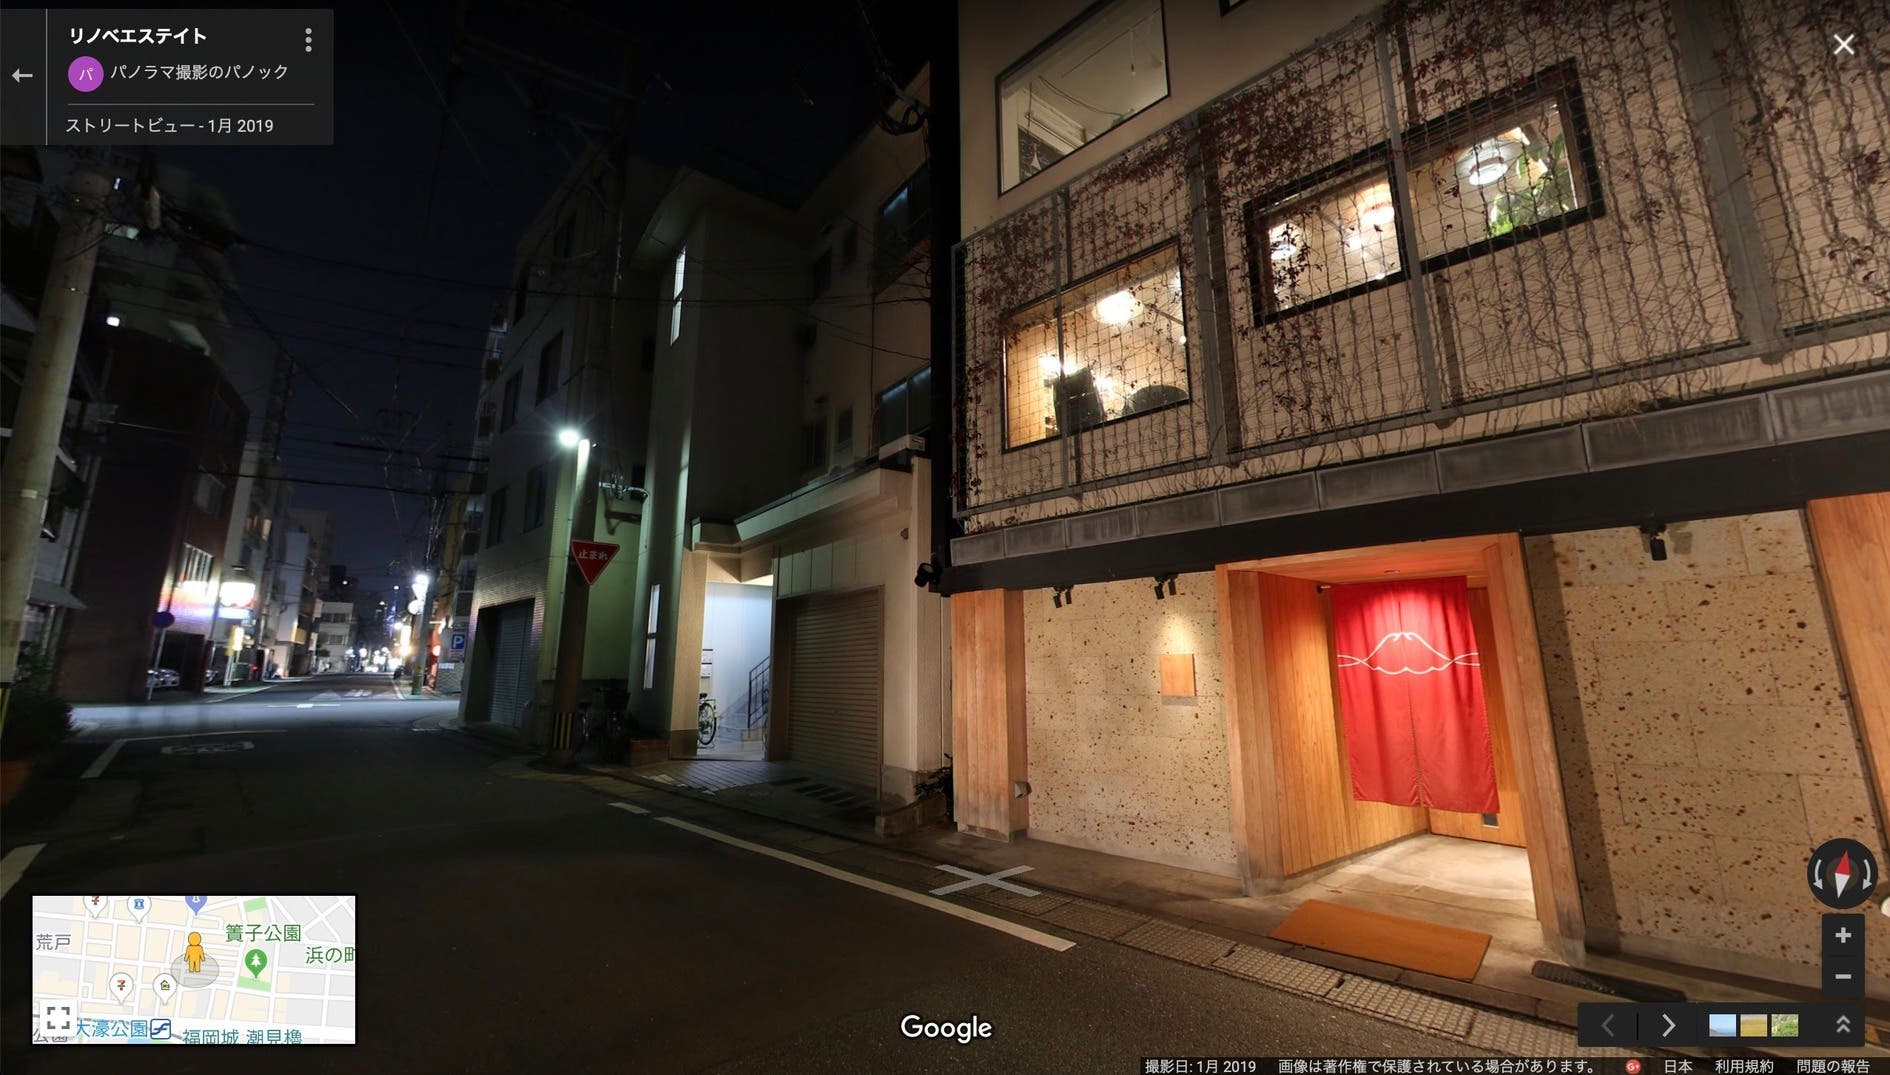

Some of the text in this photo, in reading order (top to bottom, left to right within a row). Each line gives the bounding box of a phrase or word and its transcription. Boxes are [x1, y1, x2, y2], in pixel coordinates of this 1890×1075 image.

[577, 548, 608, 560] 止まれ
[453, 635, 464, 648] P
